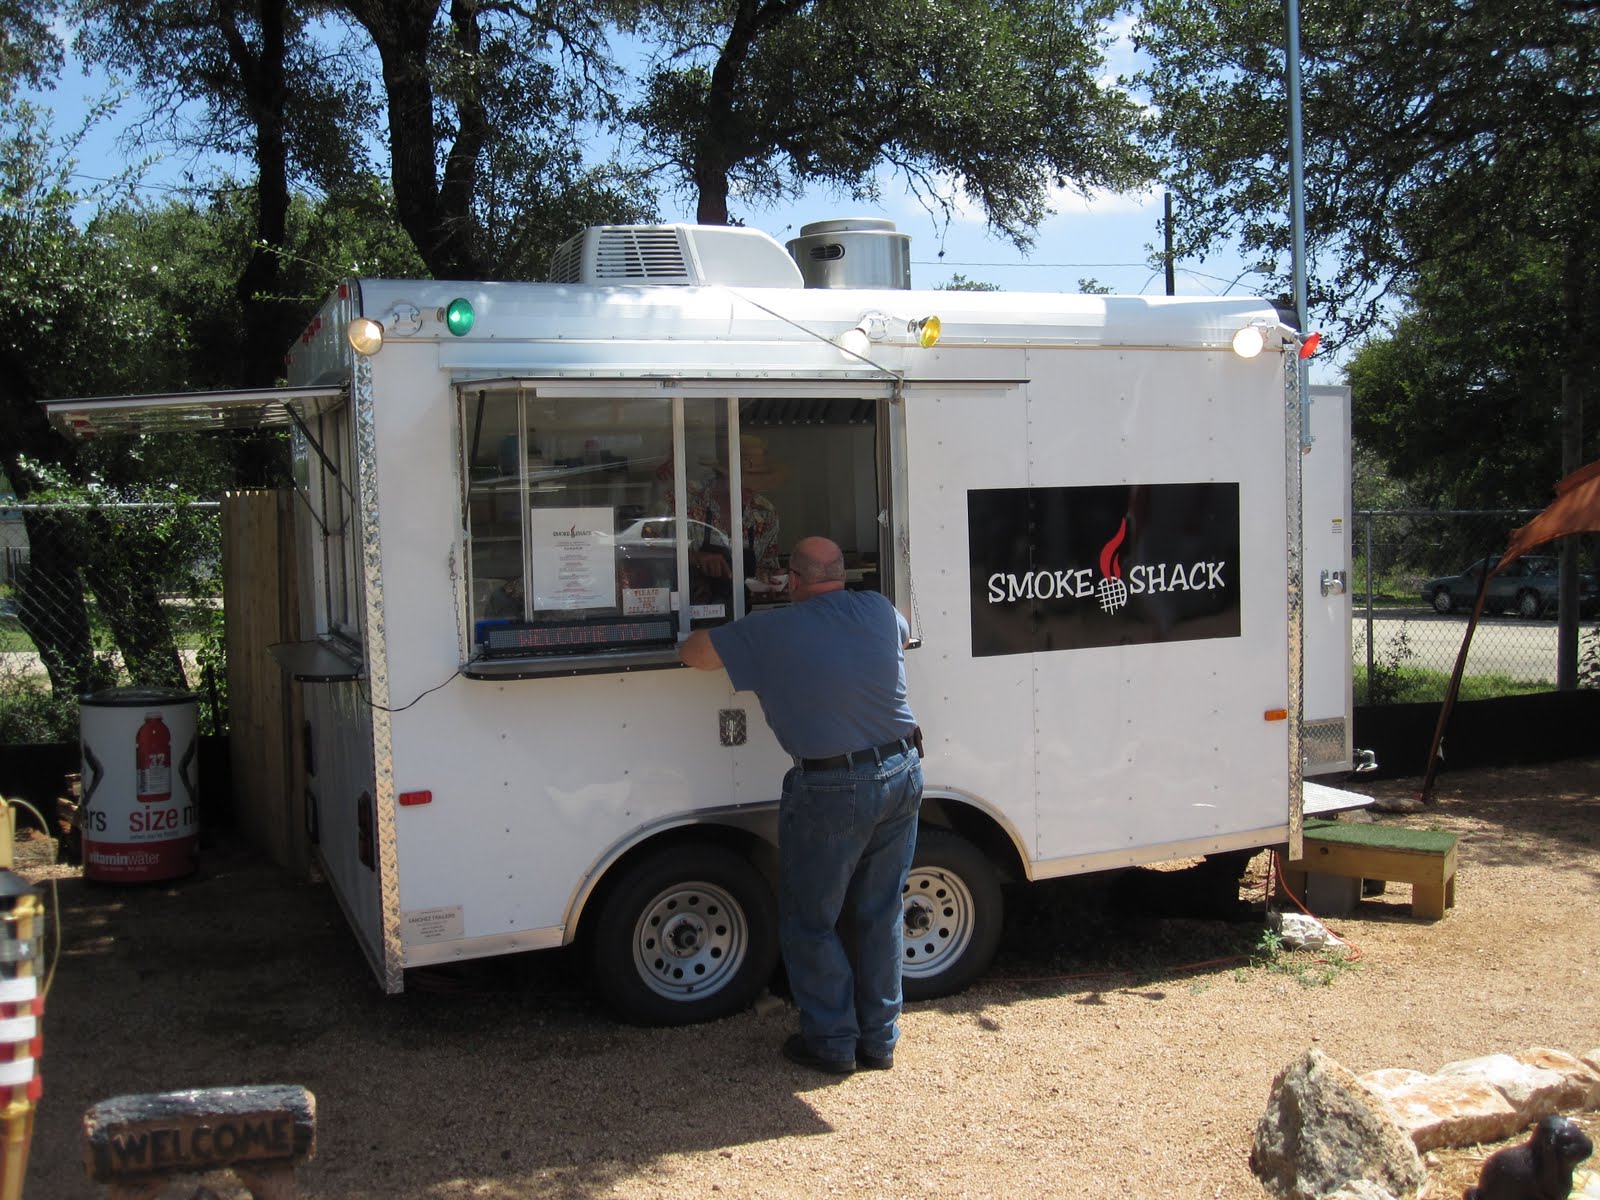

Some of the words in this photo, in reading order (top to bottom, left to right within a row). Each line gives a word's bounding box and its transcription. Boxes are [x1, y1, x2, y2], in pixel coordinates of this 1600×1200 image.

[987, 569, 1094, 603] SMOKE
[1129, 561, 1226, 594] SHACK
[518, 625, 608, 647] WELCOME
[129, 805, 179, 833] size
[112, 1117, 291, 1163] WELCOME
